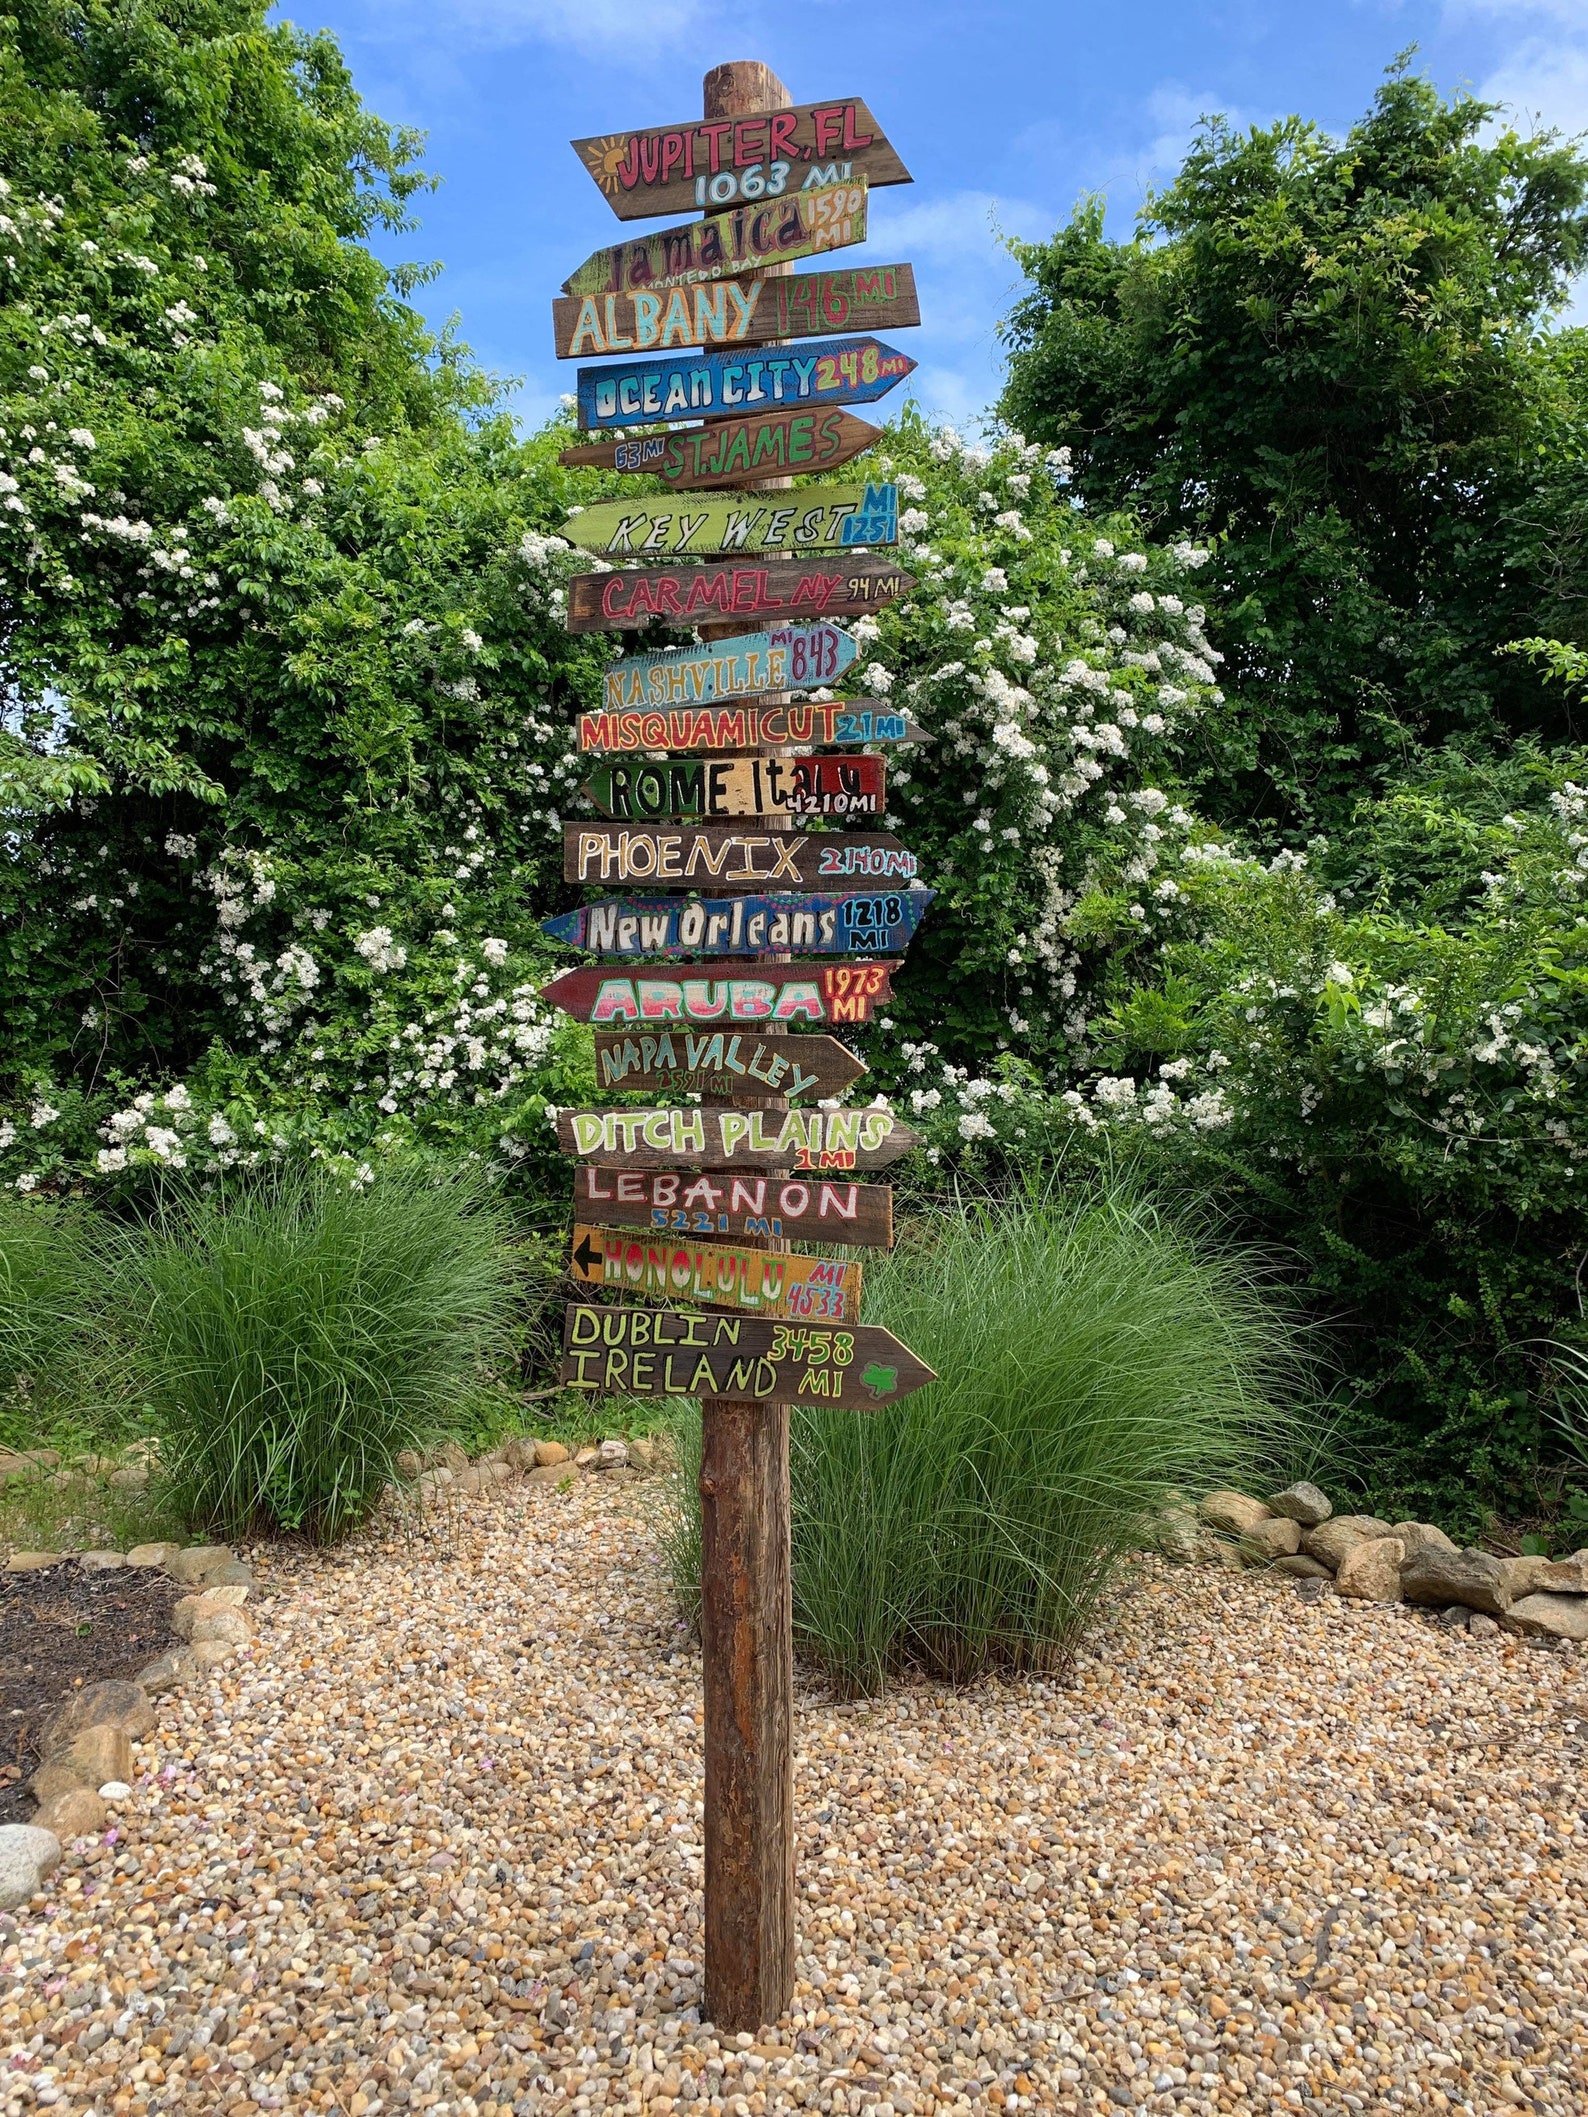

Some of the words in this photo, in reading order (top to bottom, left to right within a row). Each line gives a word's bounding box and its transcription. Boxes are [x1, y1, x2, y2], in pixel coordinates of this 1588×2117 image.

[694, 161, 791, 206] 1063
[802, 161, 853, 190] MI
[807, 186, 862, 226] 1590
[813, 218, 852, 252] MI
[732, 255, 762, 273] BAY
[570, 279, 766, 355] ALBANY
[776, 273, 851, 335] 146
[852, 268, 897, 306] MI
[595, 367, 712, 418] OCEAN
[722, 355, 820, 405] CITY
[861, 482, 898, 513] MI
[606, 511, 708, 552] KEY
[720, 502, 858, 550] WEST
[840, 513, 897, 546] 1251
[601, 570, 783, 619] CARMEL
[790, 572, 844, 610] NY
[847, 576, 871, 601] 94
[873, 576, 900, 599] MI
[605, 649, 786, 711] NASHVILLE
[791, 627, 840, 681] 843
[580, 701, 845, 750] MISQUAMICUT
[578, 830, 809, 883] PHOENIX
[586, 903, 670, 951] New
[677, 899, 838, 951] Orleans
[841, 897, 903, 929] 1218
[848, 929, 890, 951] MI
[590, 978, 827, 1022] ARUBA
[823, 965, 886, 997] 1973
[832, 996, 868, 1021] MI
[600, 1033, 677, 1086] NAPA
[685, 1033, 819, 1099] VALLEY
[710, 1074, 734, 1096] MI
[570, 1109, 706, 1157] DITCH
[718, 1109, 895, 1158] PLAINS
[793, 1147, 815, 1170] 1
[818, 1149, 856, 1171] MI
[585, 1167, 860, 1219] LEBANON
[650, 1208, 729, 1232] 5221
[744, 1216, 783, 1238] MI
[603, 1238, 787, 1306] HONOLULU
[808, 1260, 847, 1288] MI
[786, 1281, 846, 1318] 4533
[571, 1306, 742, 1348] DUBLIN
[766, 1325, 854, 1366] 3458
[565, 1348, 778, 1399] IRELAND
[798, 1367, 844, 1398] MI
